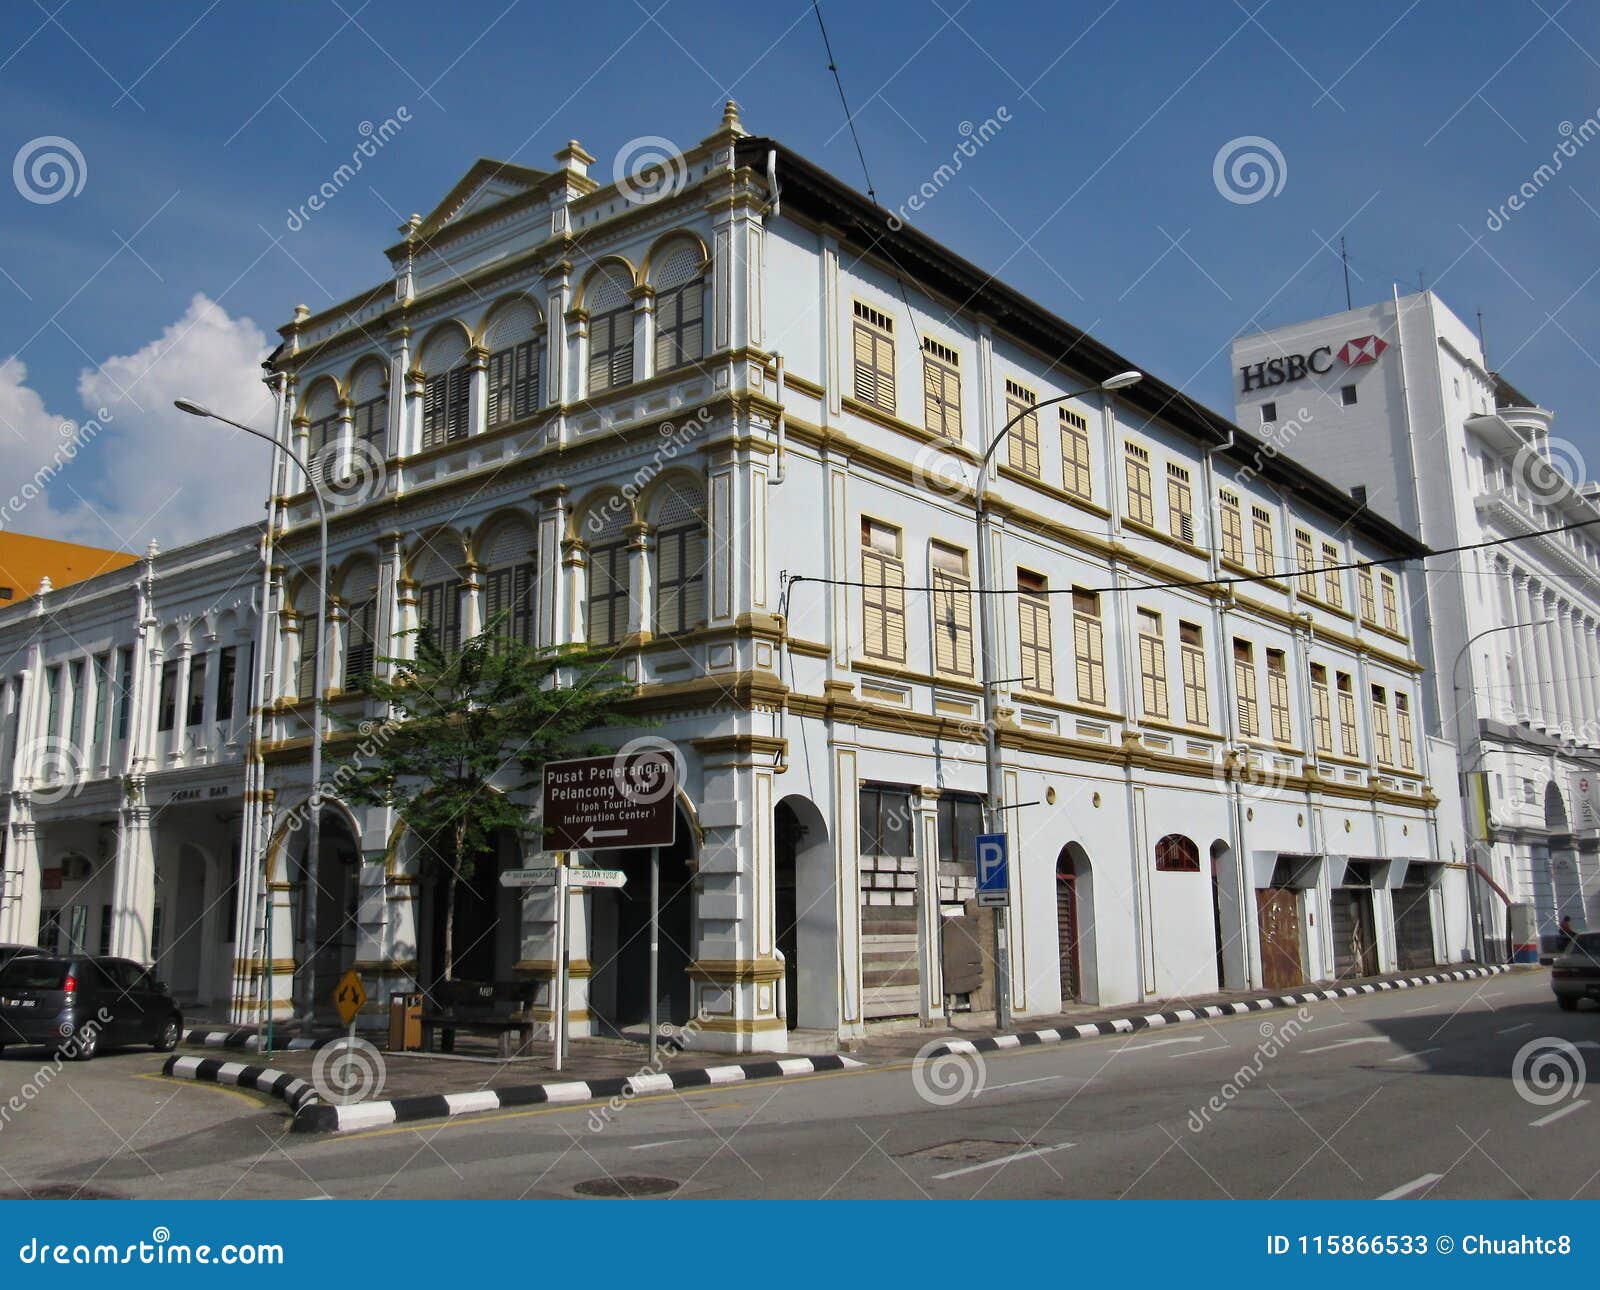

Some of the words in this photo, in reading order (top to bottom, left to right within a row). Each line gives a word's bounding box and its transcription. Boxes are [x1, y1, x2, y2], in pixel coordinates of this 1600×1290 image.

[1240, 345, 1335, 393] HSBC
[547, 769, 583, 785] Pusat
[590, 762, 669, 780] Penerangan
[551, 783, 615, 801] Pelancong
[621, 780, 650, 798] Ipoh
[604, 798, 637, 809] Tourist
[564, 812, 615, 825] Information
[980, 843, 1003, 883] P
